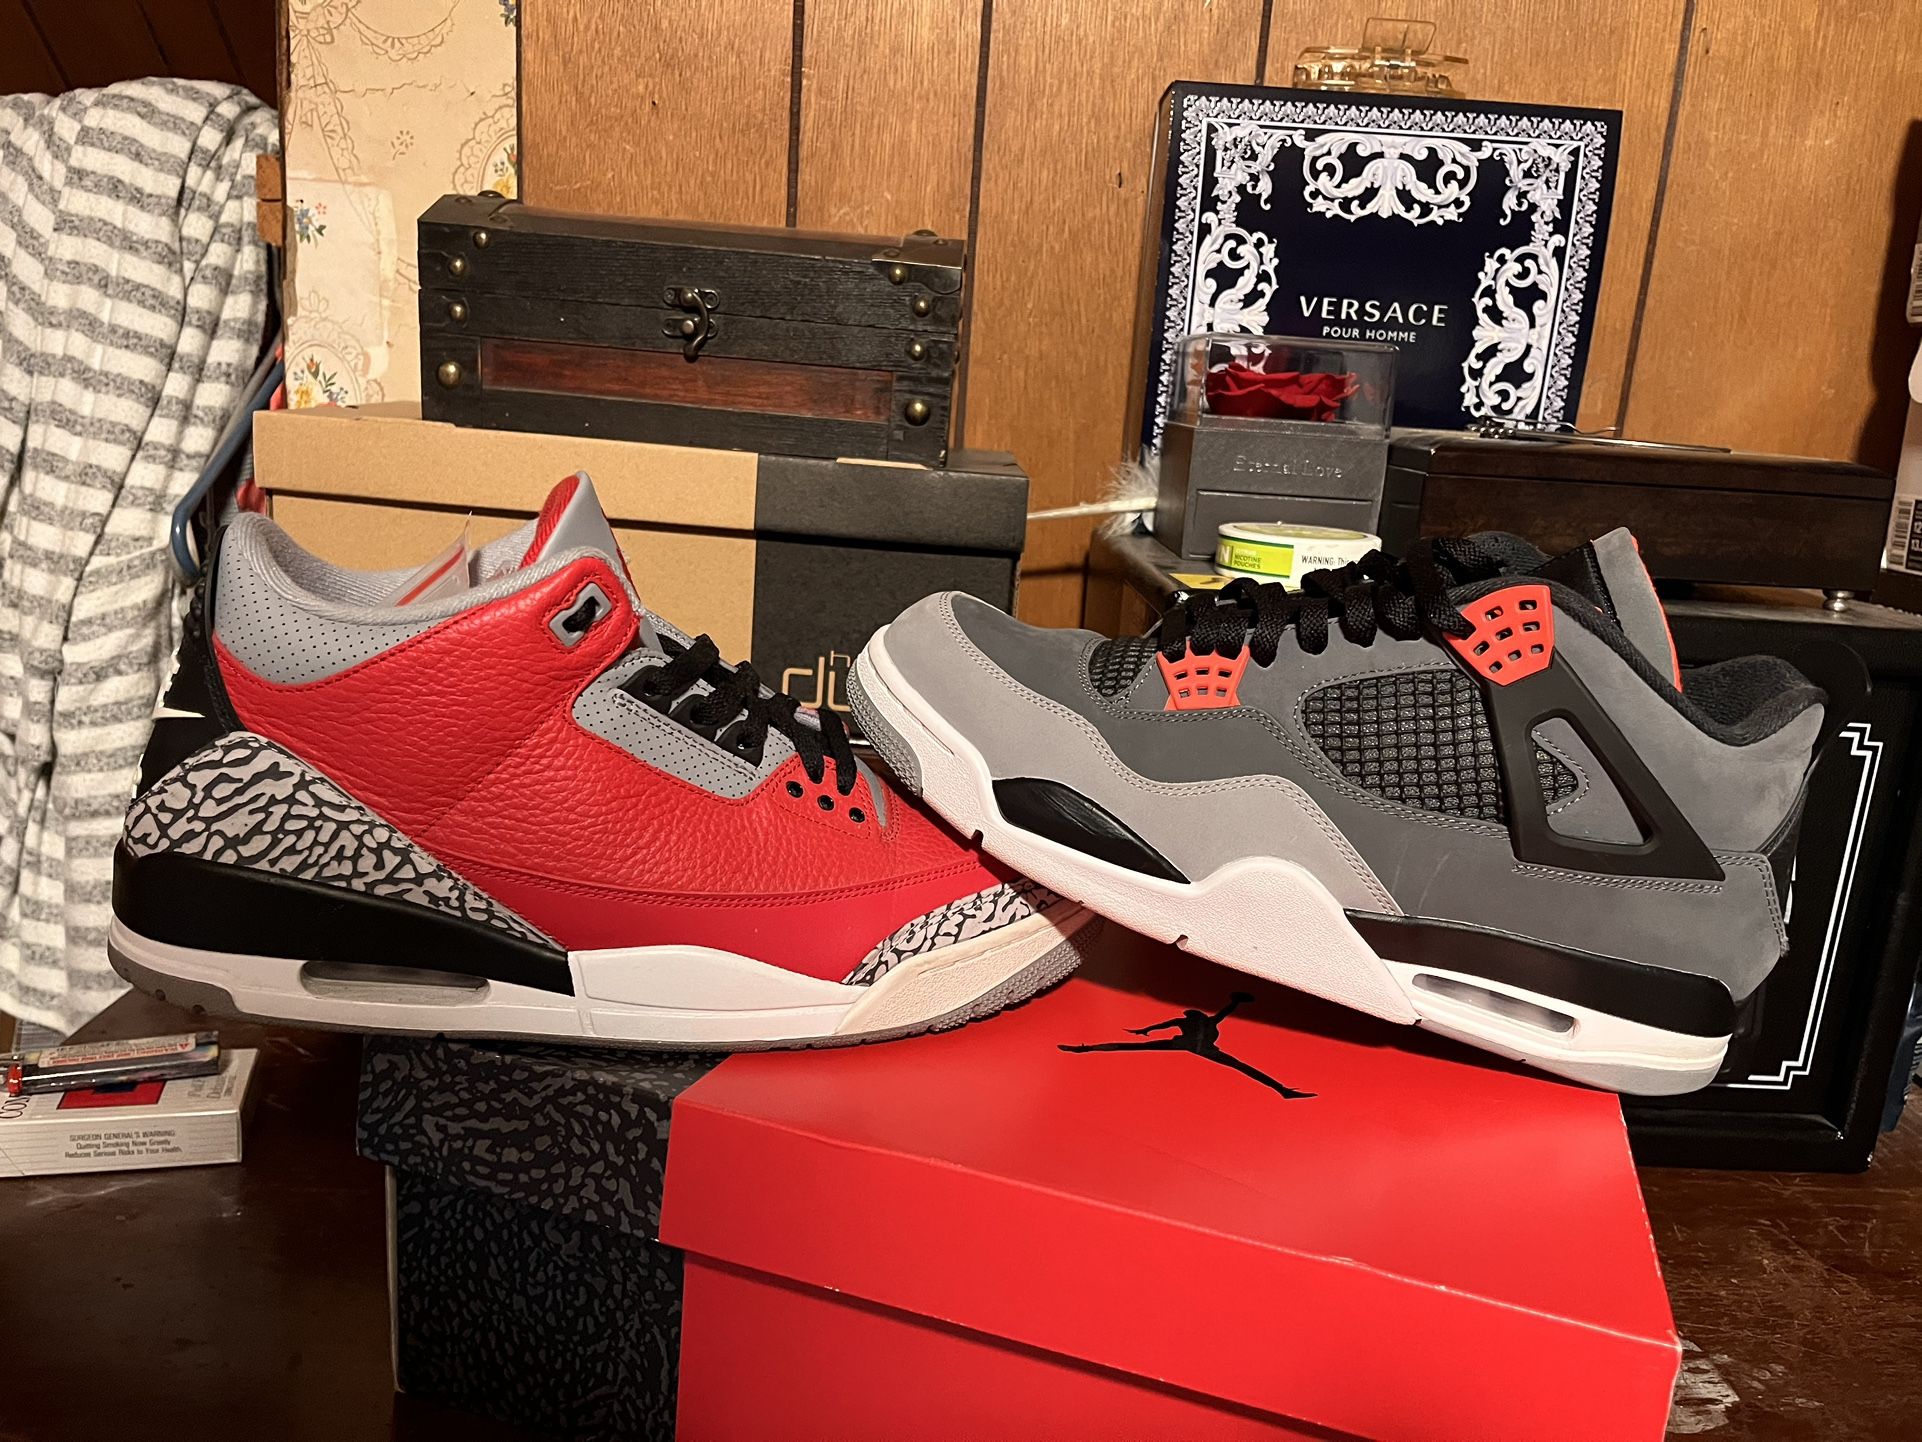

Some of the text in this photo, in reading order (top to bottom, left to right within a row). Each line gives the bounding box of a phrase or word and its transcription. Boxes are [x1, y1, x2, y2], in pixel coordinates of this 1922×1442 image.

[1299, 295, 1449, 327] VERSACE
[1322, 326, 1417, 343] POUR HOMME
[1233, 454, 1343, 478] Eternal Love
[1235, 554, 1262, 563] NICOTINE
[1234, 560, 1261, 569] POUCHES
[69, 1134, 102, 1142] SURGEON
[104, 1131, 141, 1141] GENERAL'S
[76, 1142, 101, 1150] Quitting
[102, 1141, 130, 1149] Smoking
[149, 1138, 171, 1147] Greatly
[118, 1148, 135, 1156] Risks
